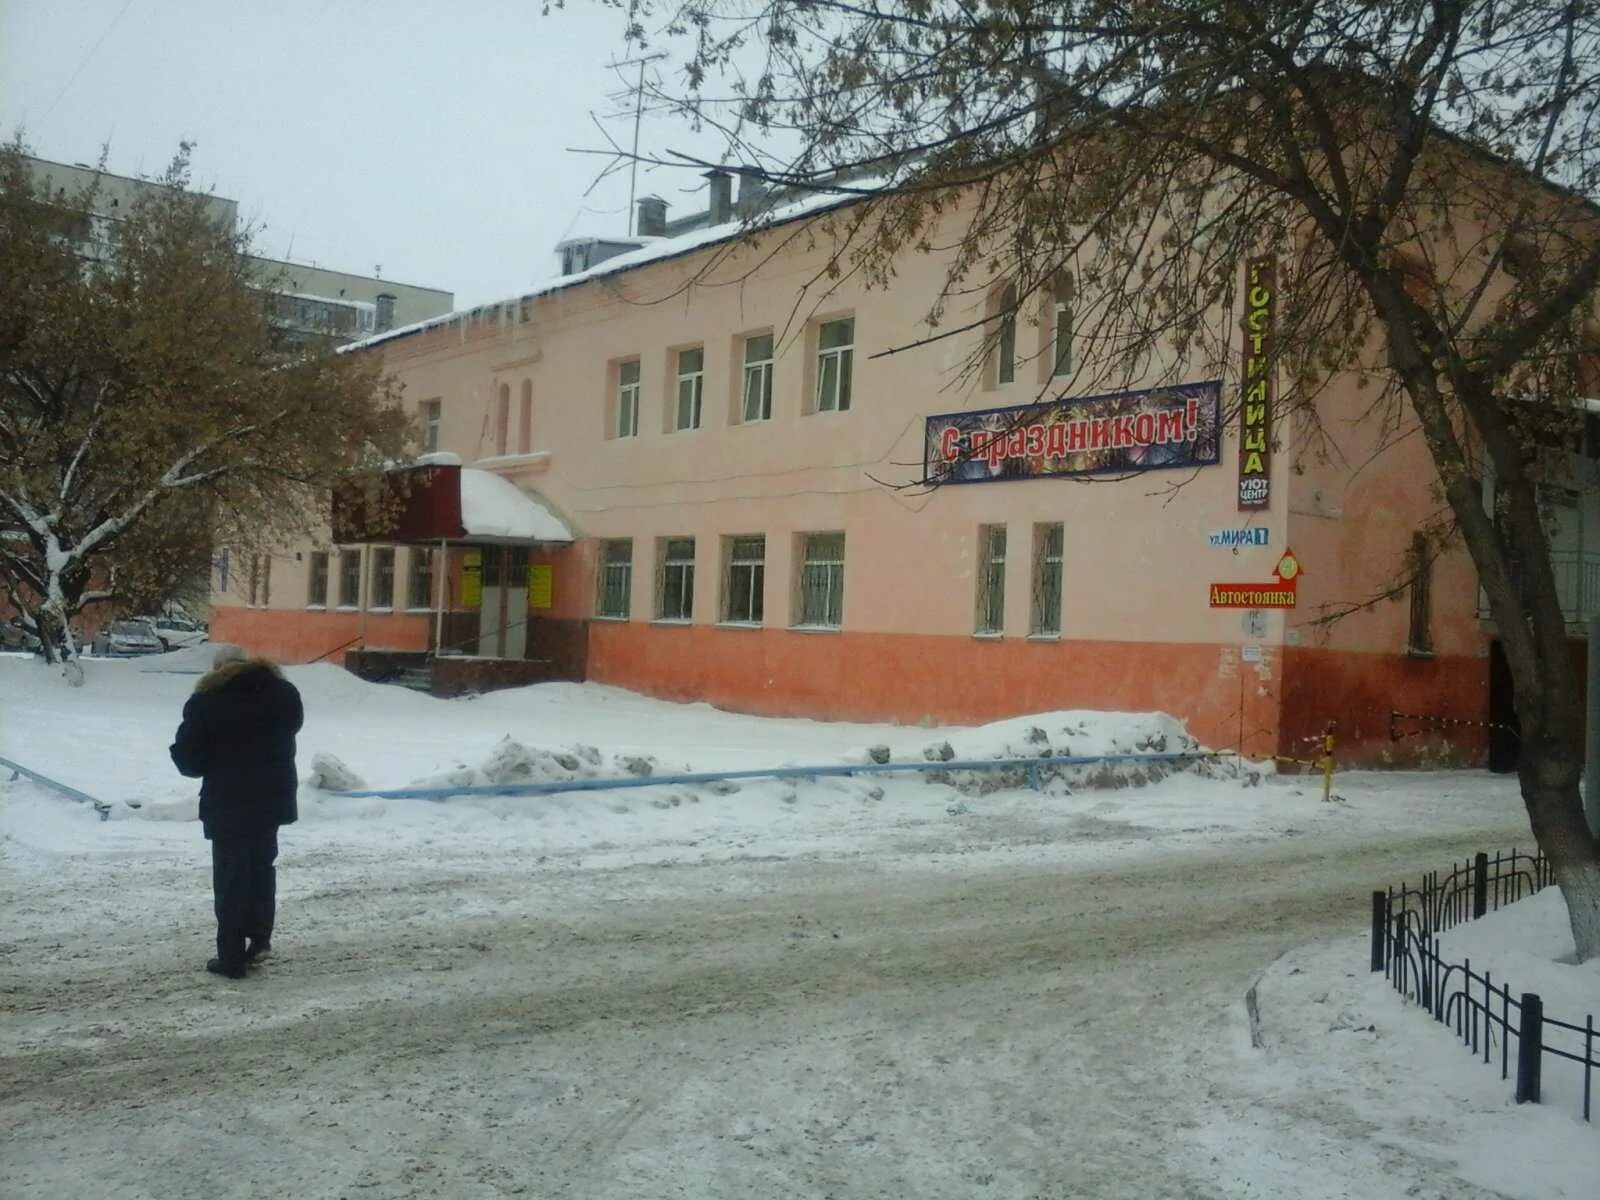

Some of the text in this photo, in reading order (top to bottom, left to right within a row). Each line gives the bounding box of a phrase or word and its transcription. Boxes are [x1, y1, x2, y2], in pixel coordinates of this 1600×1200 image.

[939, 399, 1201, 468] С праздником!
[1240, 489, 1268, 500] ЦЕНТР
[1210, 585, 1296, 605] Автостоянка
